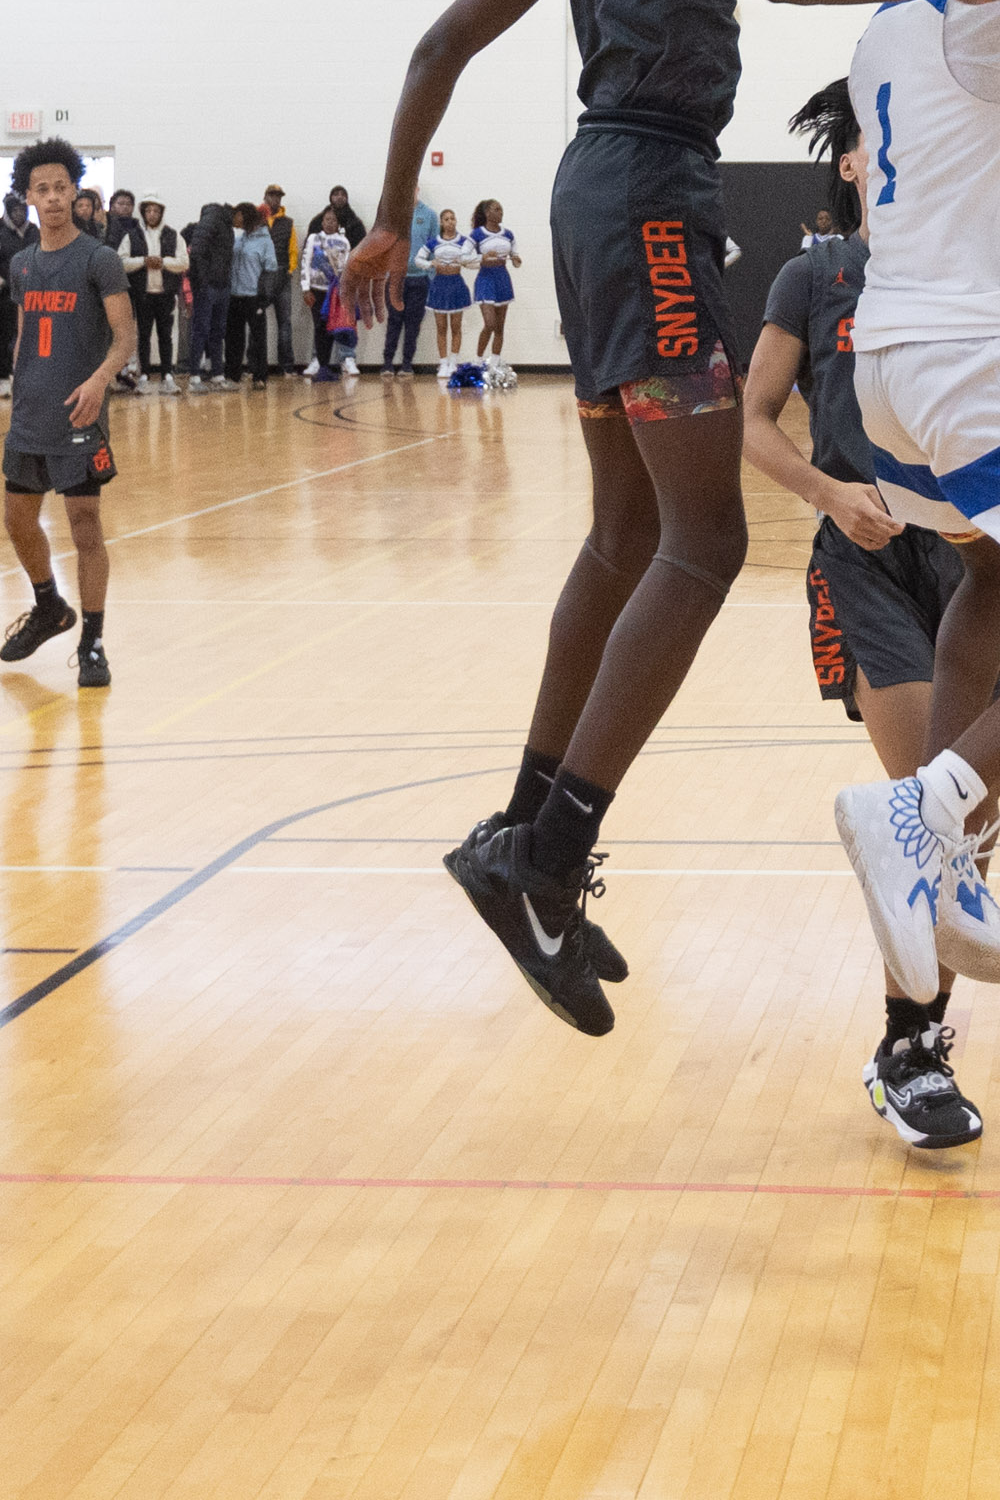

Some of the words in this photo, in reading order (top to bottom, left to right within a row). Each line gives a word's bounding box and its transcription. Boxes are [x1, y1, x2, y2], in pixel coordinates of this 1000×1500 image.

[55, 109, 69, 121] D1
[875, 81, 897, 207] 1
[642, 221, 699, 357] SNYDER
